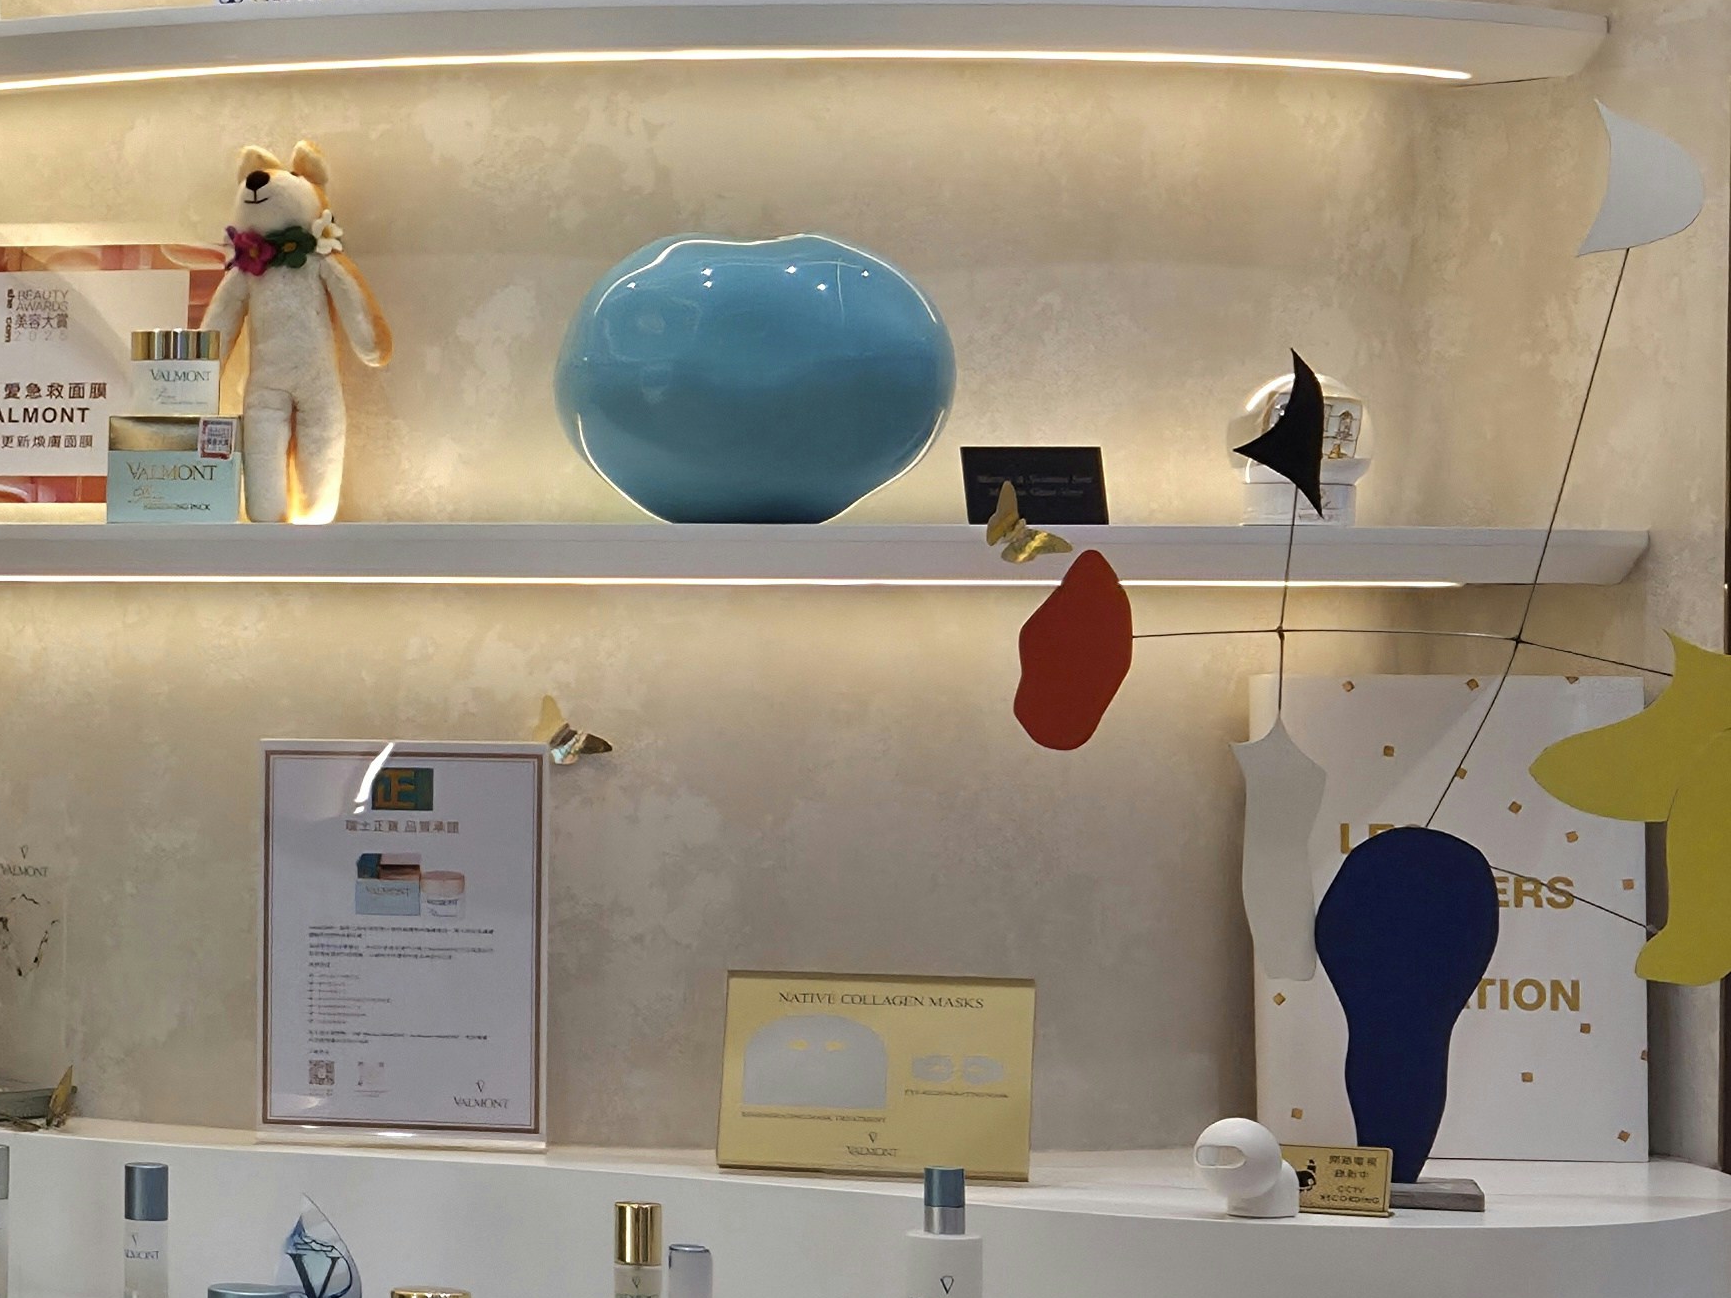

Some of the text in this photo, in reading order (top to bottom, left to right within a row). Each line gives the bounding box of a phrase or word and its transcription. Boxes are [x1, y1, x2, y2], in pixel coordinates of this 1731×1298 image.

[17, 289, 70, 301] BEAUTY
[16, 301, 70, 312] AWARDS
[14, 313, 70, 330] 美容大賞
[150, 368, 212, 383] VALMONT
[126, 460, 218, 482] VALMONT
[779, 991, 985, 1010] NATIVE COLLAGEN MASKS
[453, 1095, 509, 1110] VALMONT
